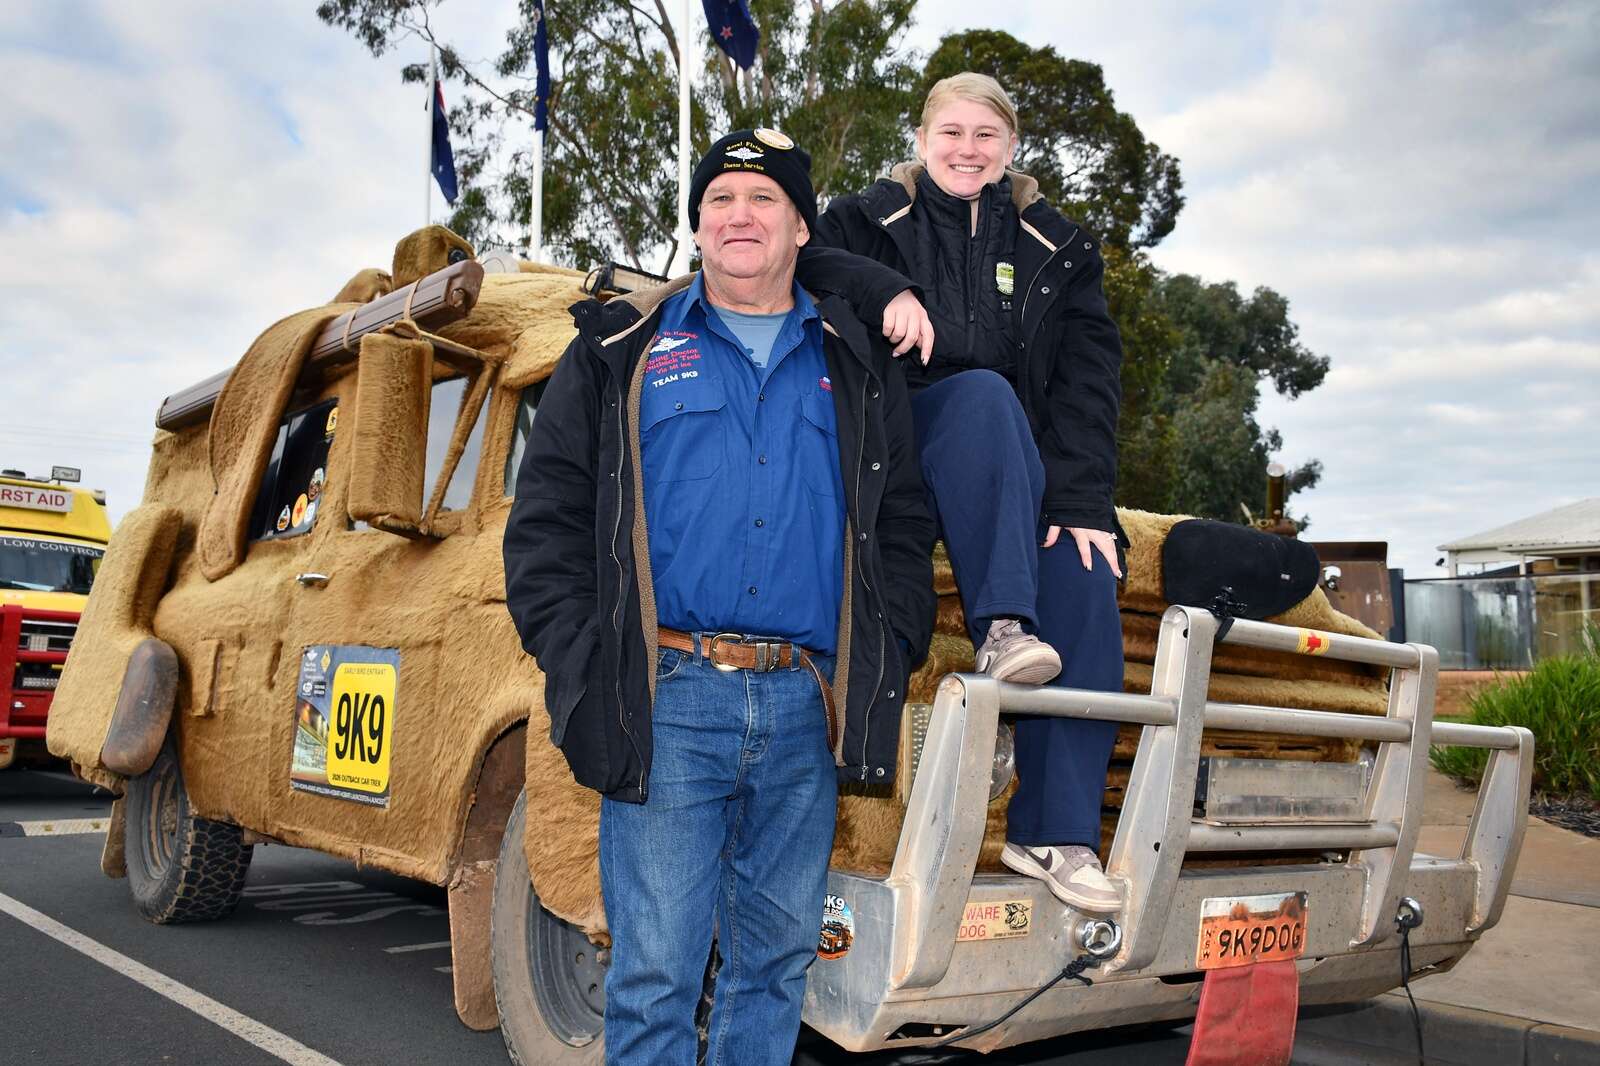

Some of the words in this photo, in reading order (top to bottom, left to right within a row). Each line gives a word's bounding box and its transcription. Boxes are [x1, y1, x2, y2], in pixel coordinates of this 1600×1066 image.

[652, 374, 679, 388] TEAM
[681, 370, 699, 379] 9K9
[0, 488, 35, 504] RST
[37, 493, 66, 507] AID
[0, 539, 36, 549] LOW
[39, 541, 103, 557] CONTROL
[335, 692, 385, 765] 9K9
[823, 895, 845, 910] K9
[967, 906, 1001, 920] WARE
[959, 924, 986, 938] DOG
[1218, 921, 1301, 958] 9K9DOG
